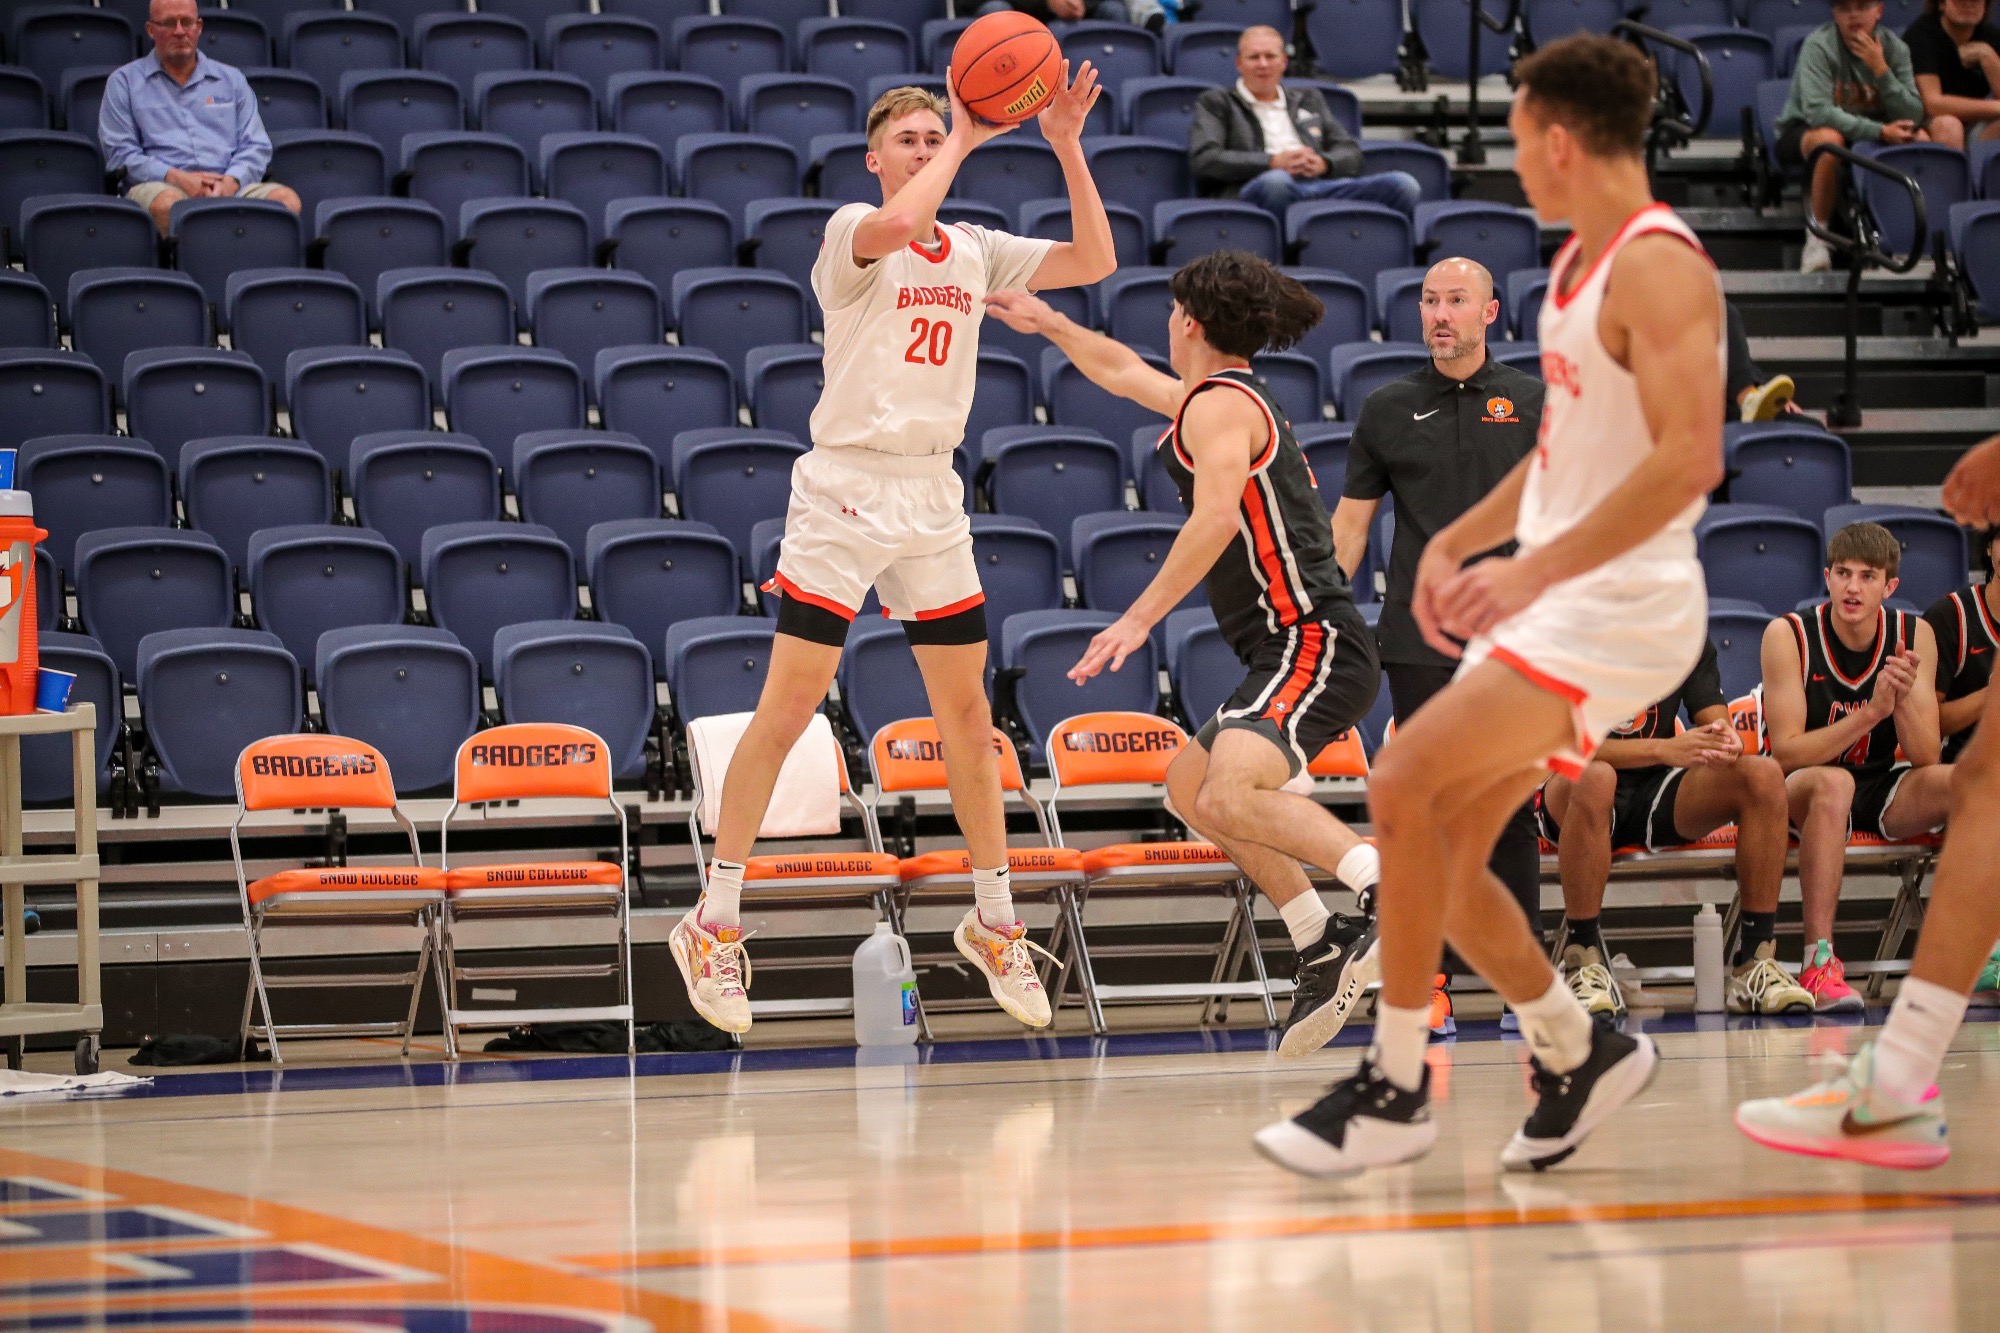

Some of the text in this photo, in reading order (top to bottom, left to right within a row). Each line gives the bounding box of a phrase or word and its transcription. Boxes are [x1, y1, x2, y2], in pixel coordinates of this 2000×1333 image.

[1007, 79, 1046, 114] NJCAA
[897, 285, 972, 316] BADGERS
[905, 317, 953, 366] 20
[886, 738, 1003, 761] BADS
[1062, 731, 1179, 753] BADGERS
[252, 754, 377, 777] BADGERS
[471, 743, 596, 767] BADGERS
[1008, 855, 1055, 867] OLLEGE
[1144, 849, 1180, 861] SNOW
[487, 868, 588, 882] SNOW COLLEGE
[776, 860, 873, 874] SNOW COLLEGE
[320, 873, 419, 886] SNOW COLLEGE
